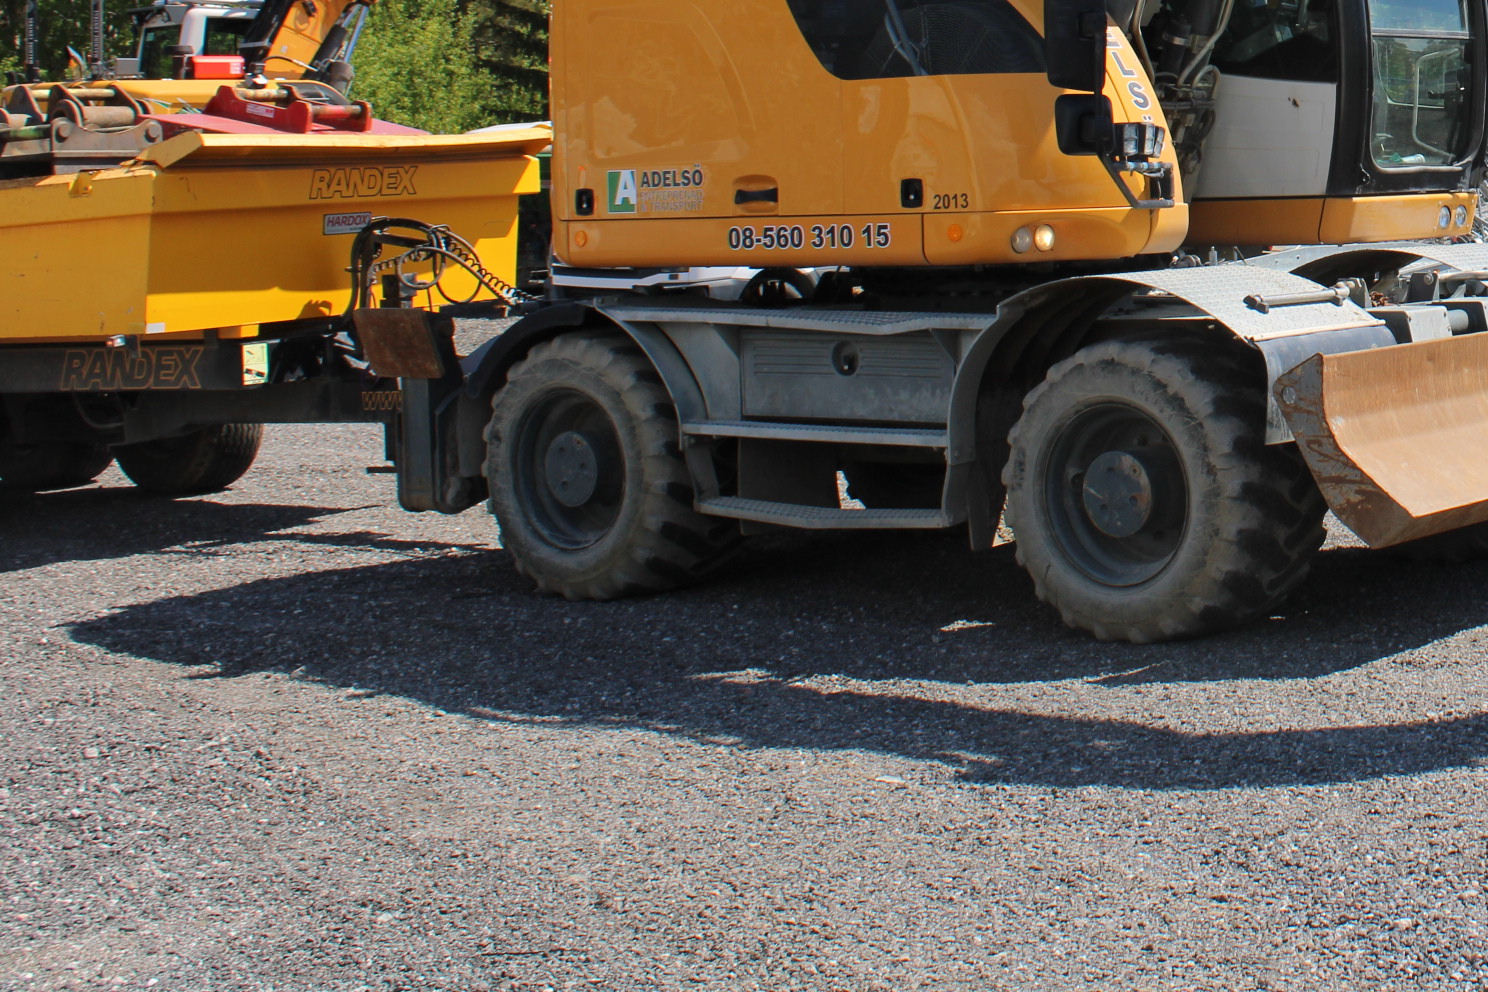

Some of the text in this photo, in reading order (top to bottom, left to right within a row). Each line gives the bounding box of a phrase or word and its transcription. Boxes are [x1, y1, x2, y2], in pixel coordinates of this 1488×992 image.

[308, 165, 418, 200] RANDEX
[640, 163, 704, 188] ADELSÖ
[640, 189, 704, 202] ENTREPRENAD
[650, 200, 703, 212] TRANSPORT
[933, 193, 969, 210] 2013
[326, 214, 369, 227] HARDOX
[728, 222, 891, 251] 08-560 310 15
[60, 347, 203, 391] RANDEX
